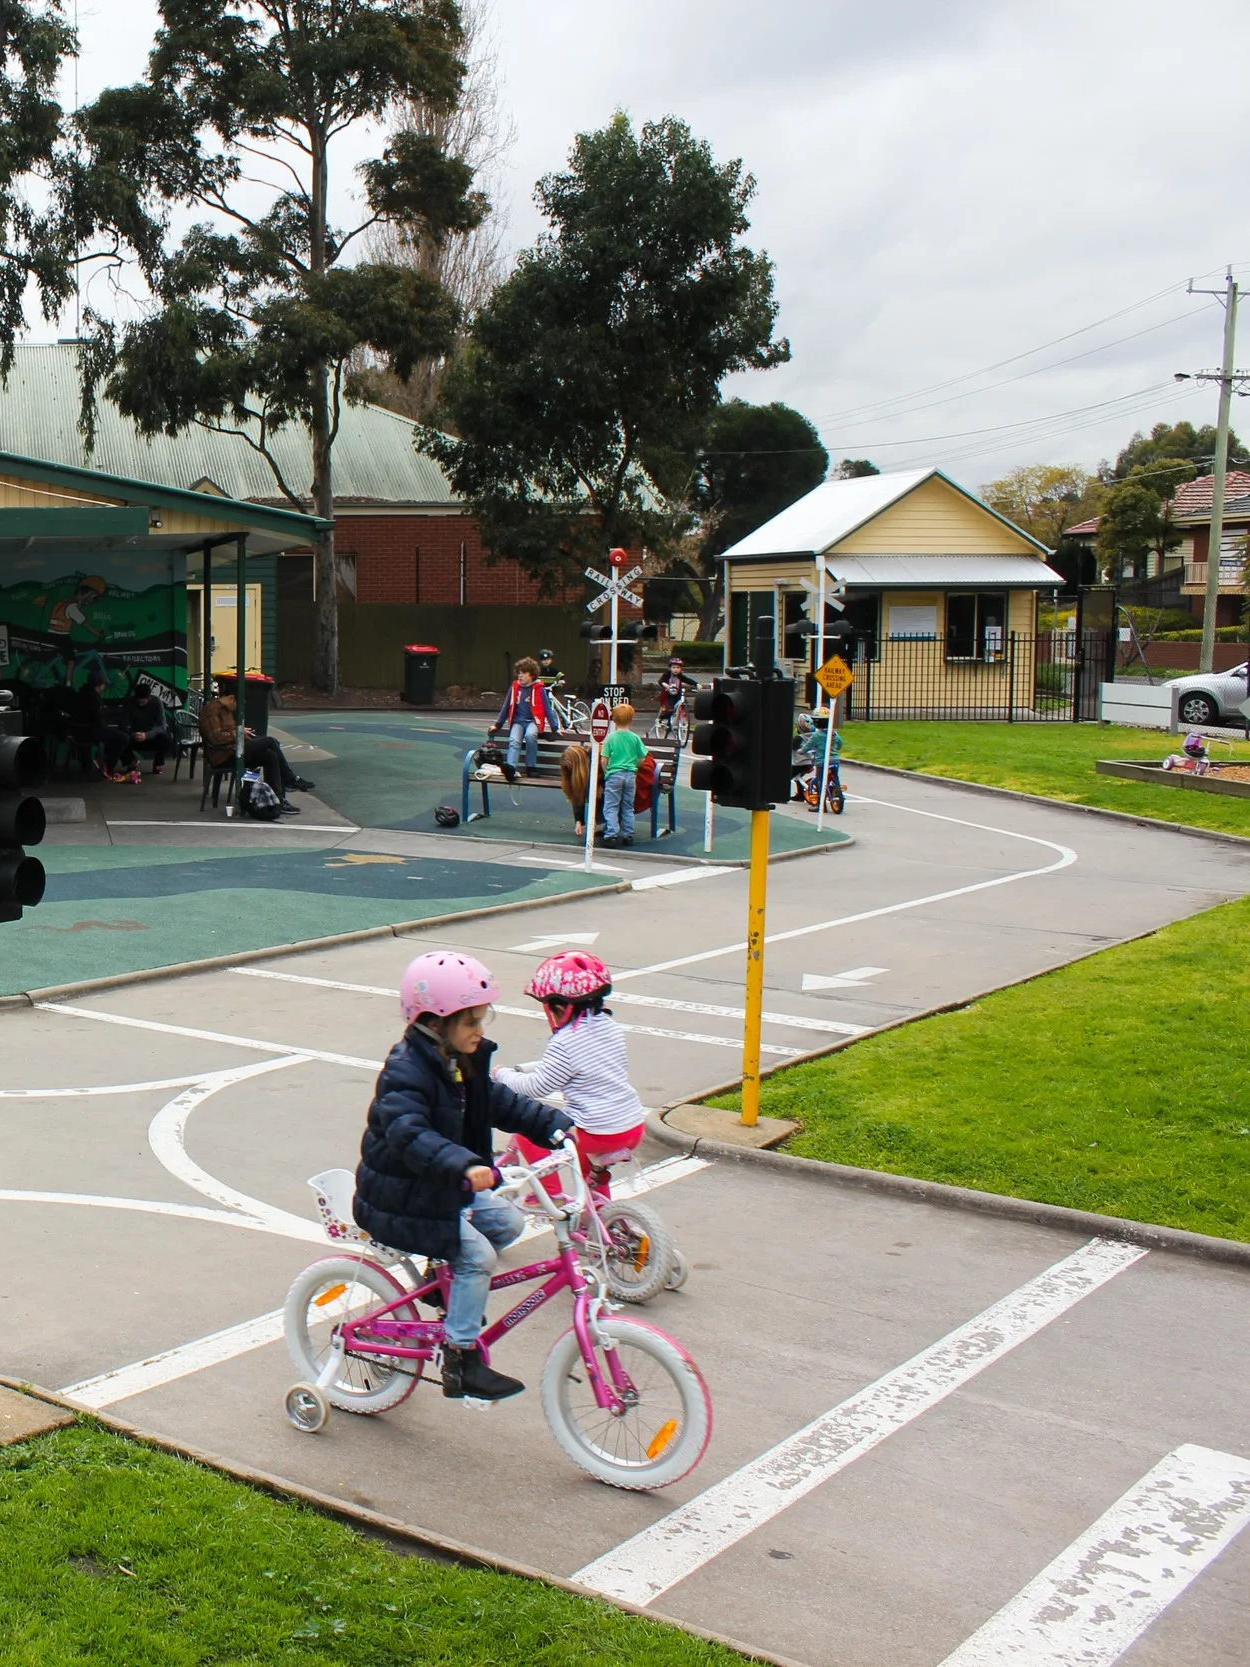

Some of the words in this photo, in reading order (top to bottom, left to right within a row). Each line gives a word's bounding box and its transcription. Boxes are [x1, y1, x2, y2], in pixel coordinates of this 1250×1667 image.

[589, 568, 640, 610] CROSSING
[822, 674, 847, 682] CROSSING
[603, 687, 625, 697] STOP
[503, 1289, 546, 1328] mongoose
